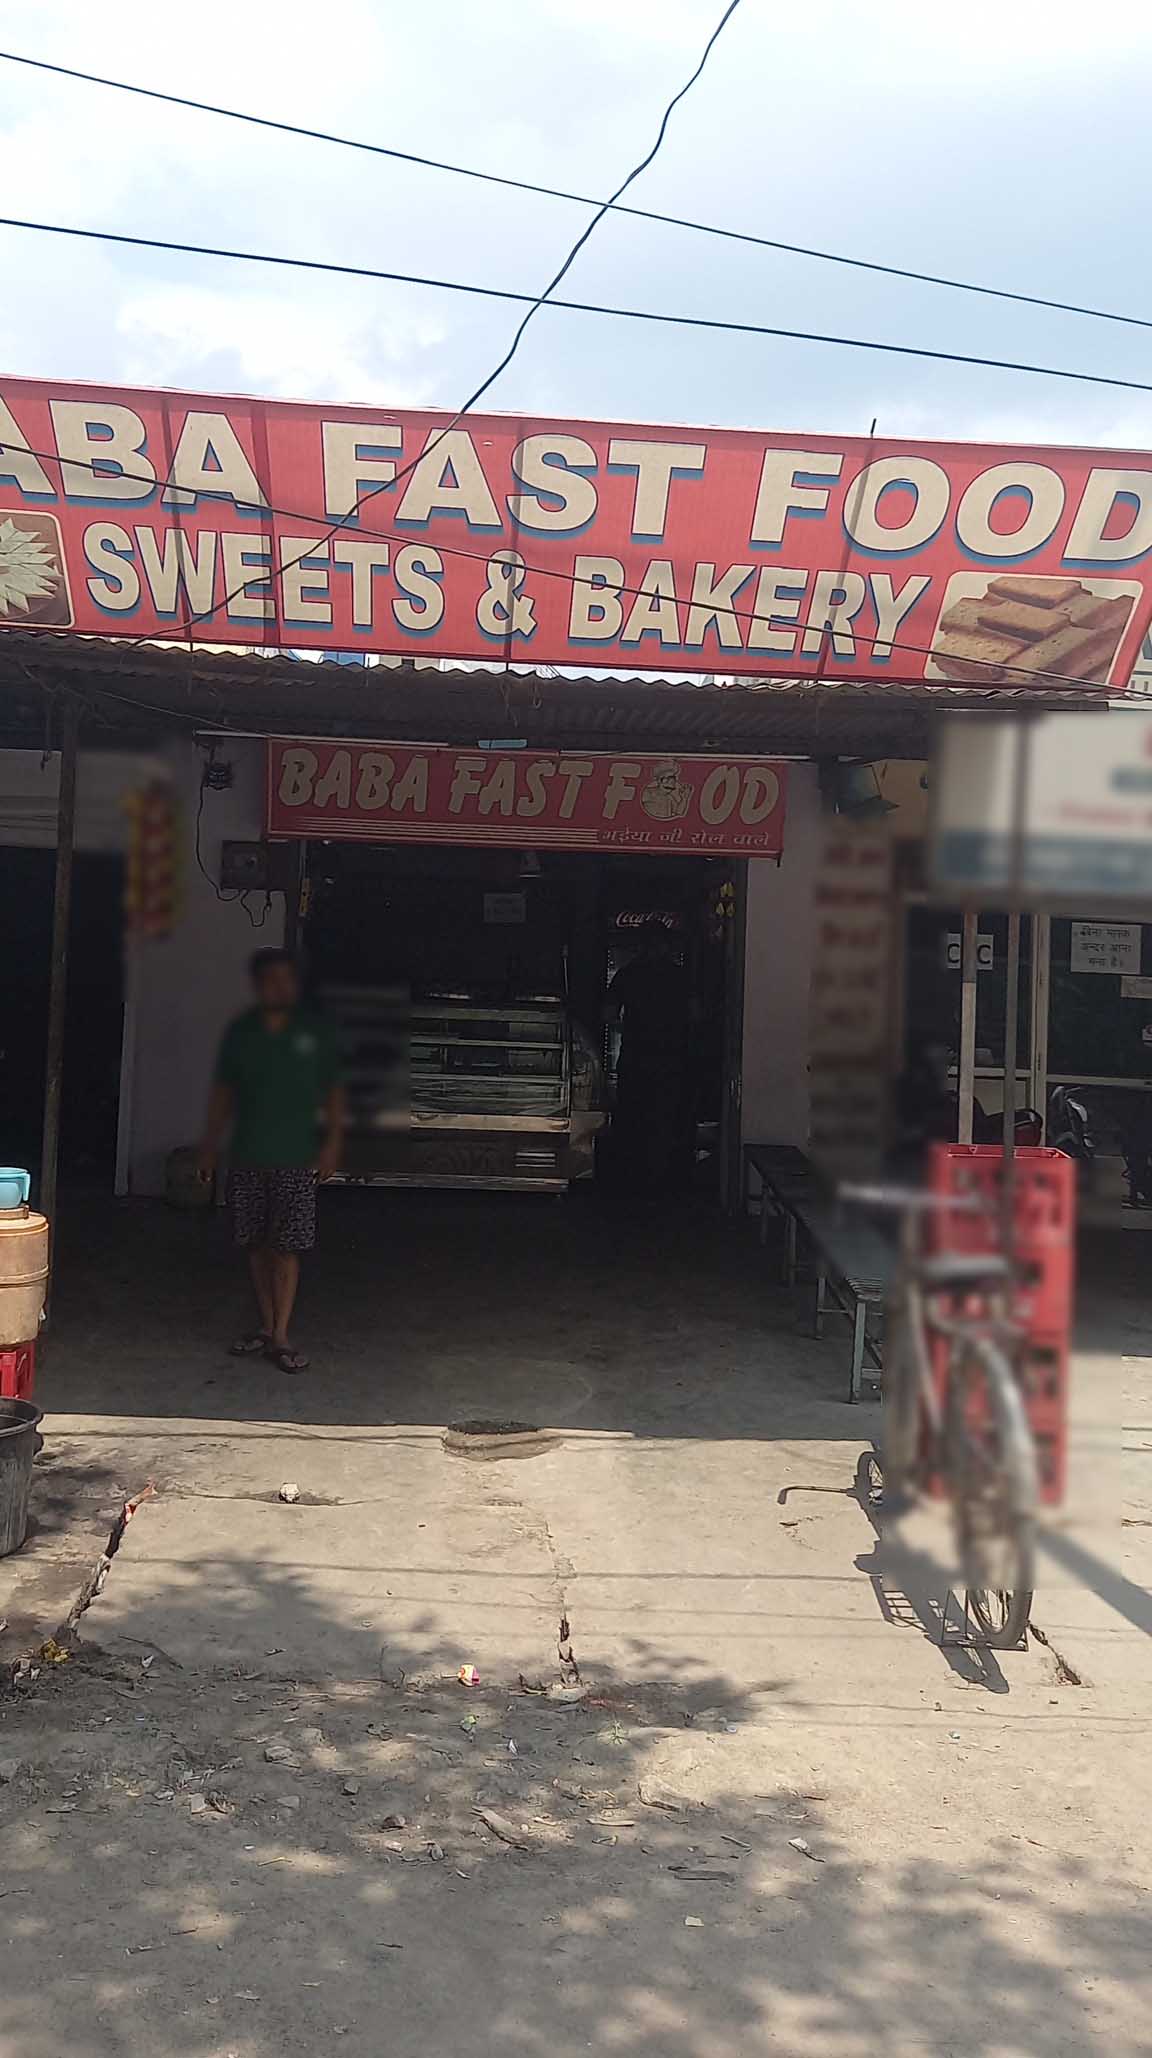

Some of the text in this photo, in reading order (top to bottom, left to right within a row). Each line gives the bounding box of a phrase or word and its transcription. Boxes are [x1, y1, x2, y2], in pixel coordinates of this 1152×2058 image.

[320, 420, 708, 540] FAST
[748, 447, 1152, 562] FOOD
[83, 520, 932, 659] SWEETS & BAKERY
[277, 747, 780, 826] BABA FAST FOD
